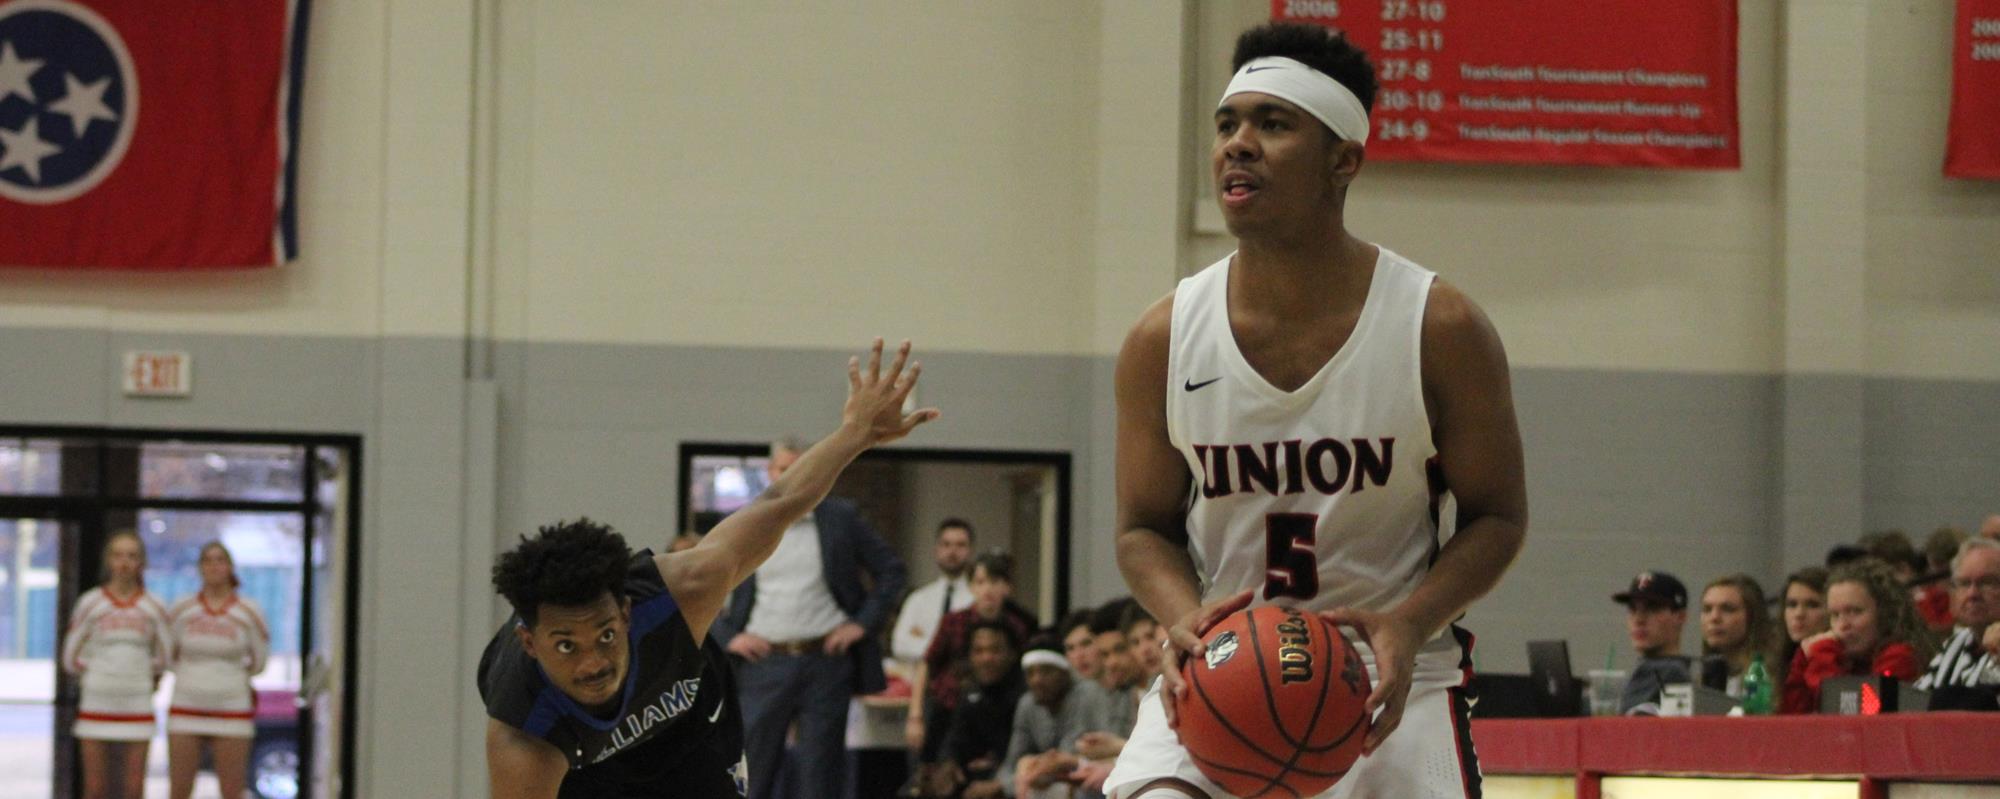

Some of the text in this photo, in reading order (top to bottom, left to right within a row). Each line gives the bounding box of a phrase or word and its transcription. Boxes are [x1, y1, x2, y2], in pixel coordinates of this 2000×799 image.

[1381, 0, 1447, 22] 27-10
[1380, 58, 1432, 82] 27-8
[1536, 66, 1624, 85] Tournament
[1626, 68, 1708, 88] Champions
[1535, 97, 1621, 115] Tournament
[1592, 128, 1645, 145] Season
[1646, 128, 1728, 149] Champions
[136, 353, 181, 391] EXIT
[1192, 437, 1396, 499] UNION
[1262, 512, 1319, 601] 5
